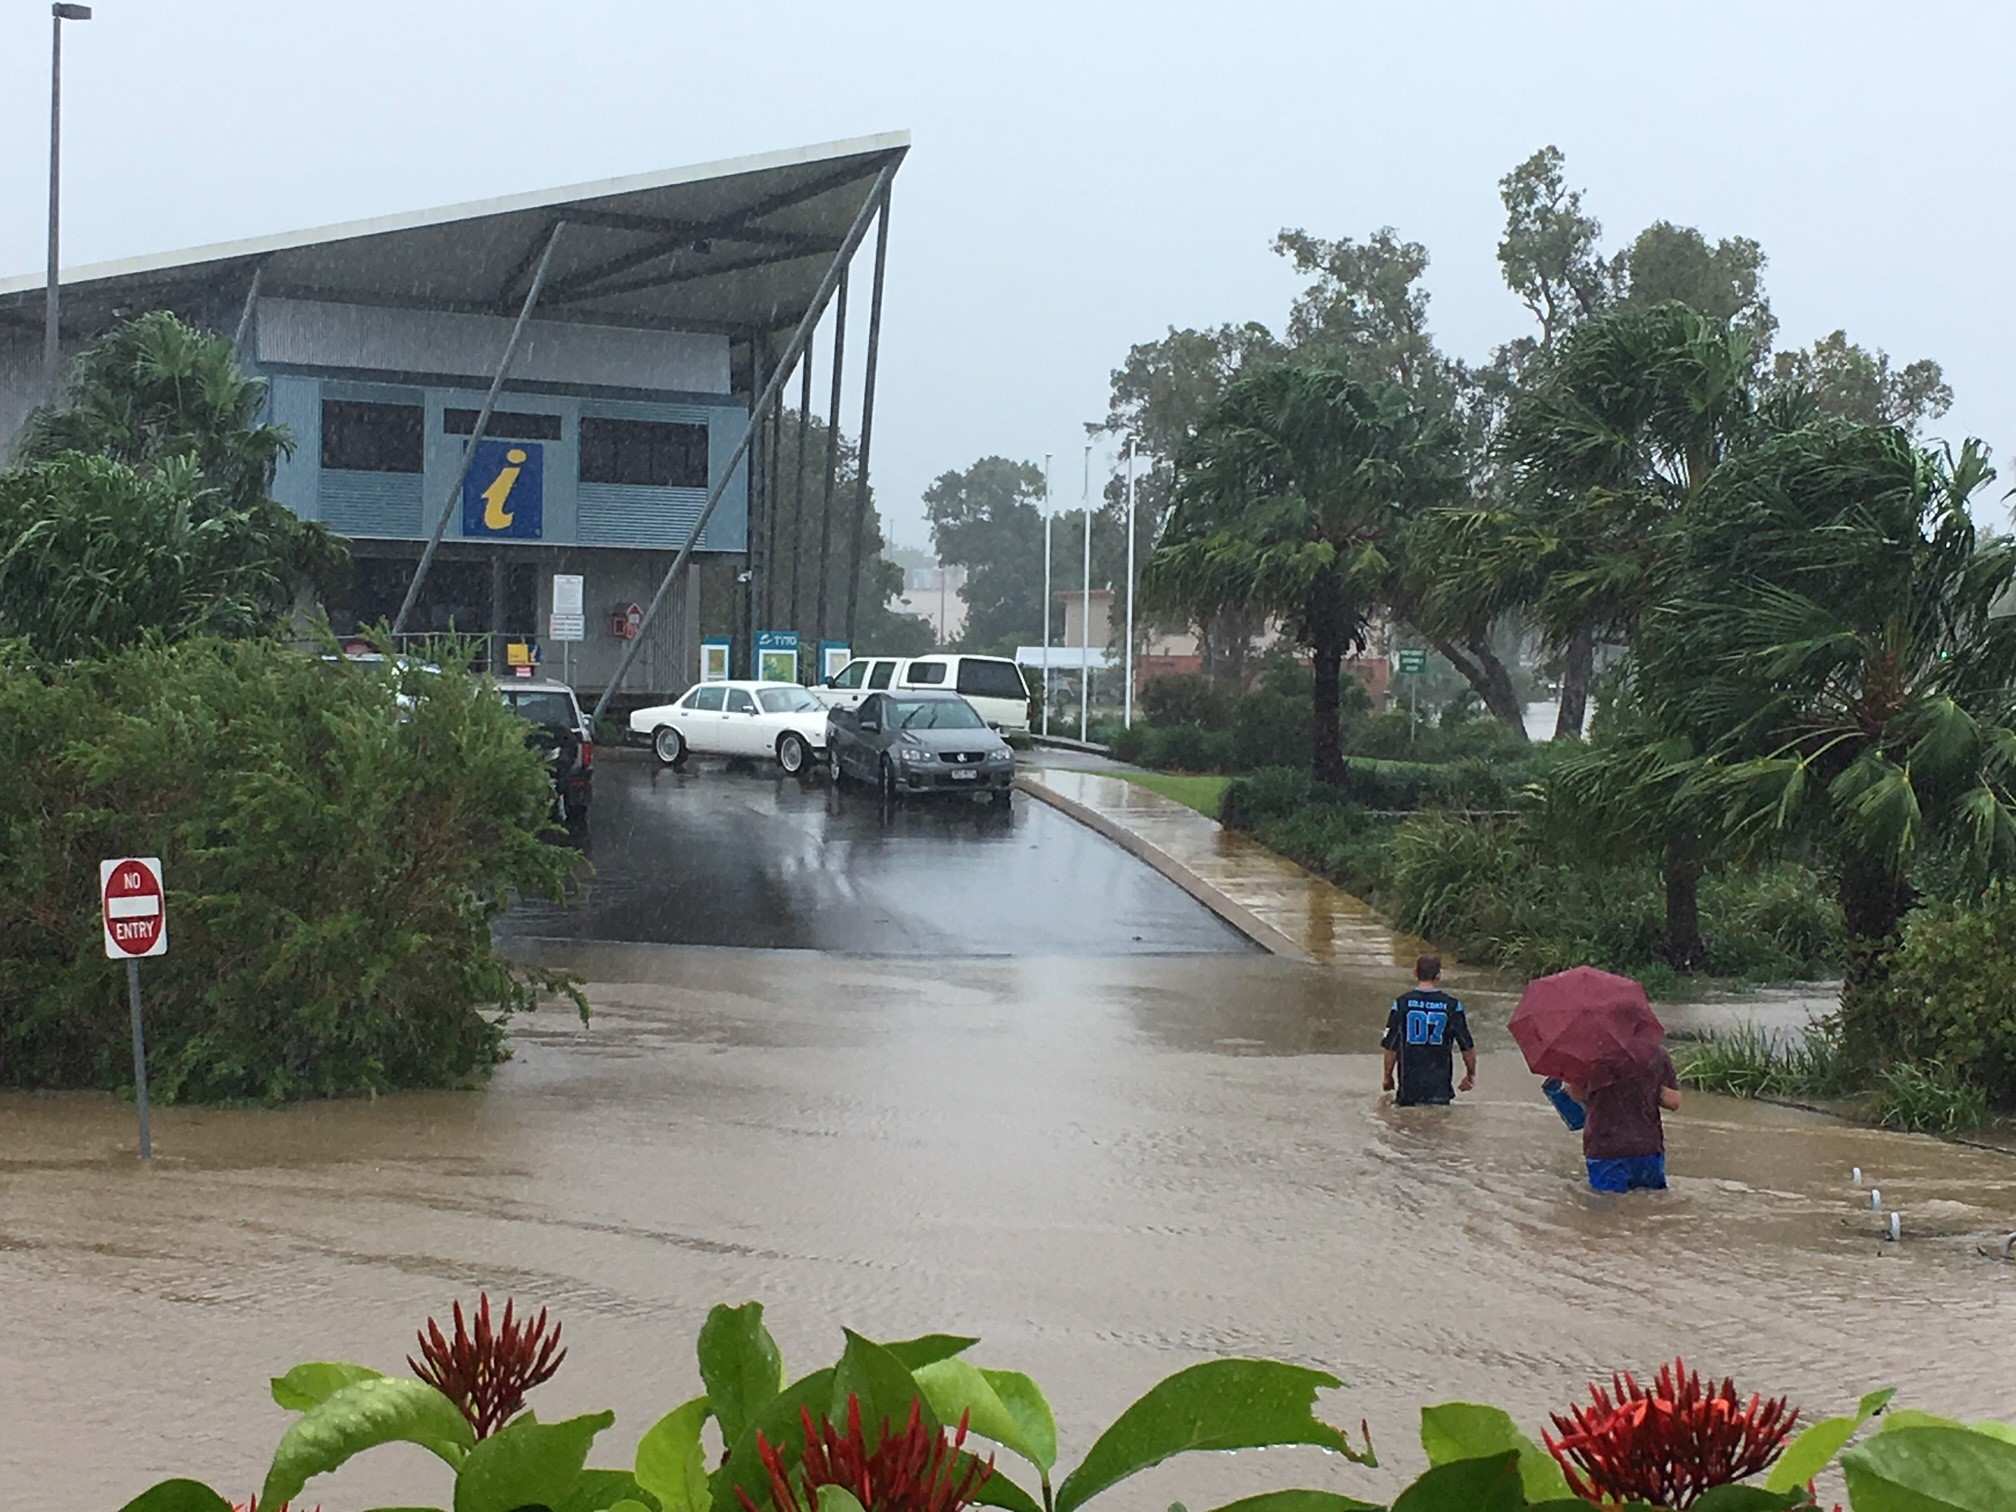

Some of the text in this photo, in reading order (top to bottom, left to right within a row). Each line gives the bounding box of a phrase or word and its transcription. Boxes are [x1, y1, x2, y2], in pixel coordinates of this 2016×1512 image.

[123, 872, 141, 890] NO
[116, 921, 154, 940] ENTRY
[1406, 1010, 1448, 1045] 07
